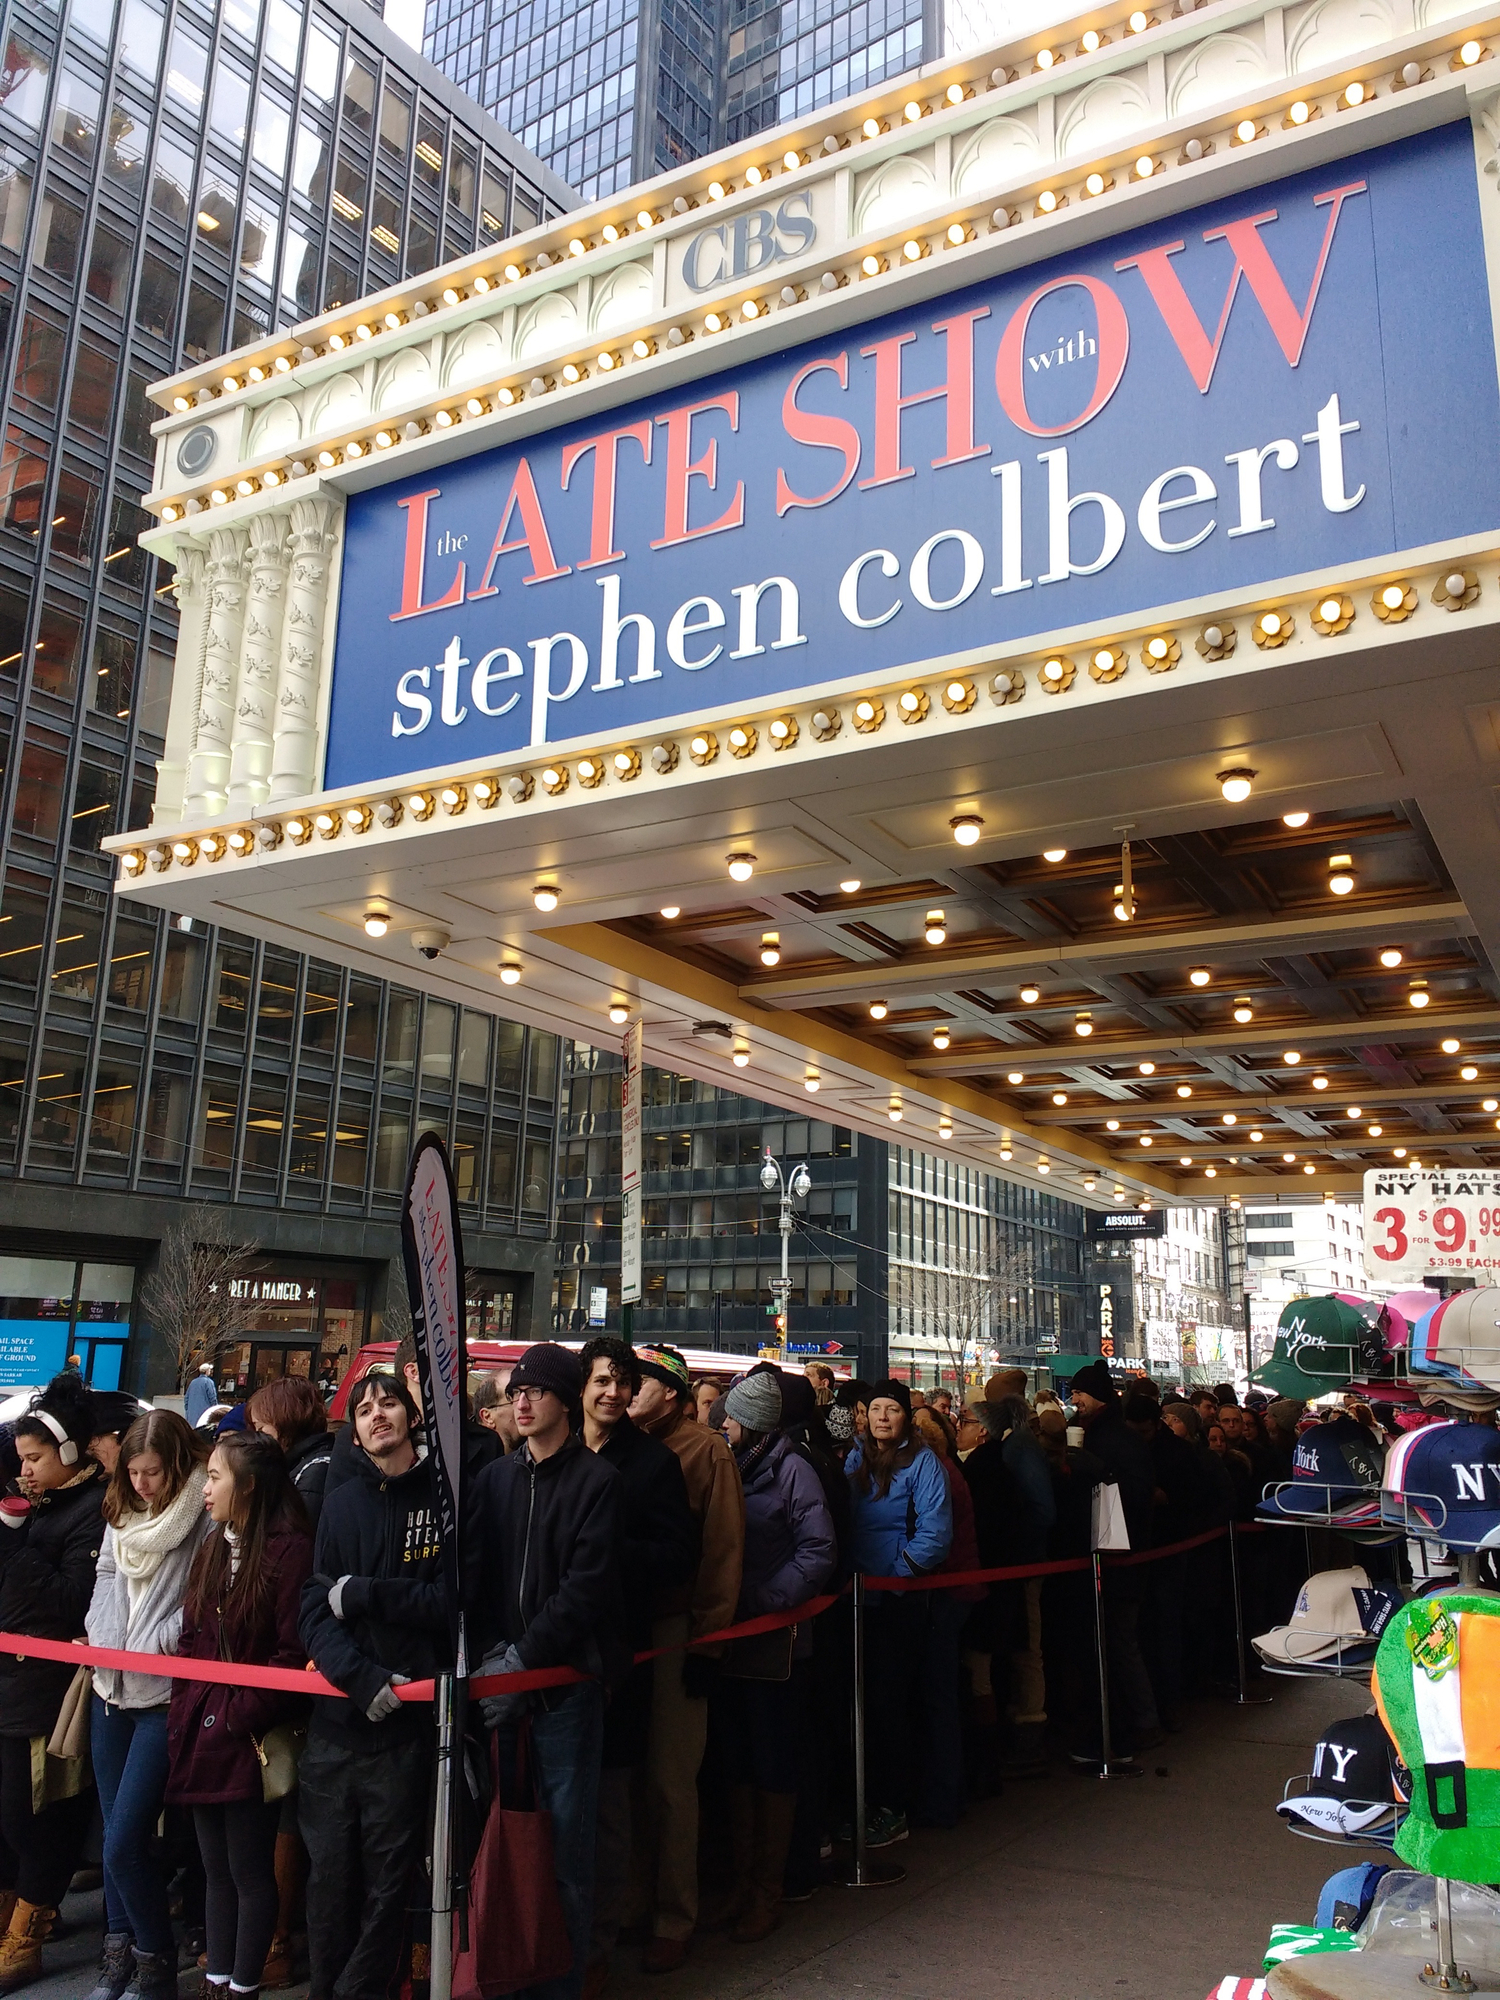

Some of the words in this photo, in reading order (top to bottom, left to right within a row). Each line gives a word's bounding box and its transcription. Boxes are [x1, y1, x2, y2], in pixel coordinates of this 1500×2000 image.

[682, 189, 817, 294] CBS
[1027, 330, 1098, 374] with
[389, 391, 746, 622] LATE
[776, 180, 1368, 517] SHOW
[436, 530, 469, 557] the
[391, 574, 808, 747] stephen
[838, 393, 1367, 629] colbert
[1375, 1182, 1417, 1196] NY
[1373, 1207, 1408, 1262] 3
[1429, 1258, 1462, 1267] $3.99
[1466, 1258, 1500, 1268] EACH
[228, 1279, 250, 1299] RET
[251, 1281, 259, 1299] A
[261, 1281, 301, 1301] MANGER
[1100, 1285, 1113, 1338] PARK
[0, 1346, 28, 1354] ILABLE
[4, 1354, 37, 1362] GROUND
[1107, 1357, 1146, 1369] PARK
[1296, 1444, 1320, 1472] York
[403, 1545, 440, 1562] SURF
[1312, 1742, 1358, 1783] NY
[1301, 1805, 1323, 1816] New
[1325, 1811, 1347, 1829] Yok
